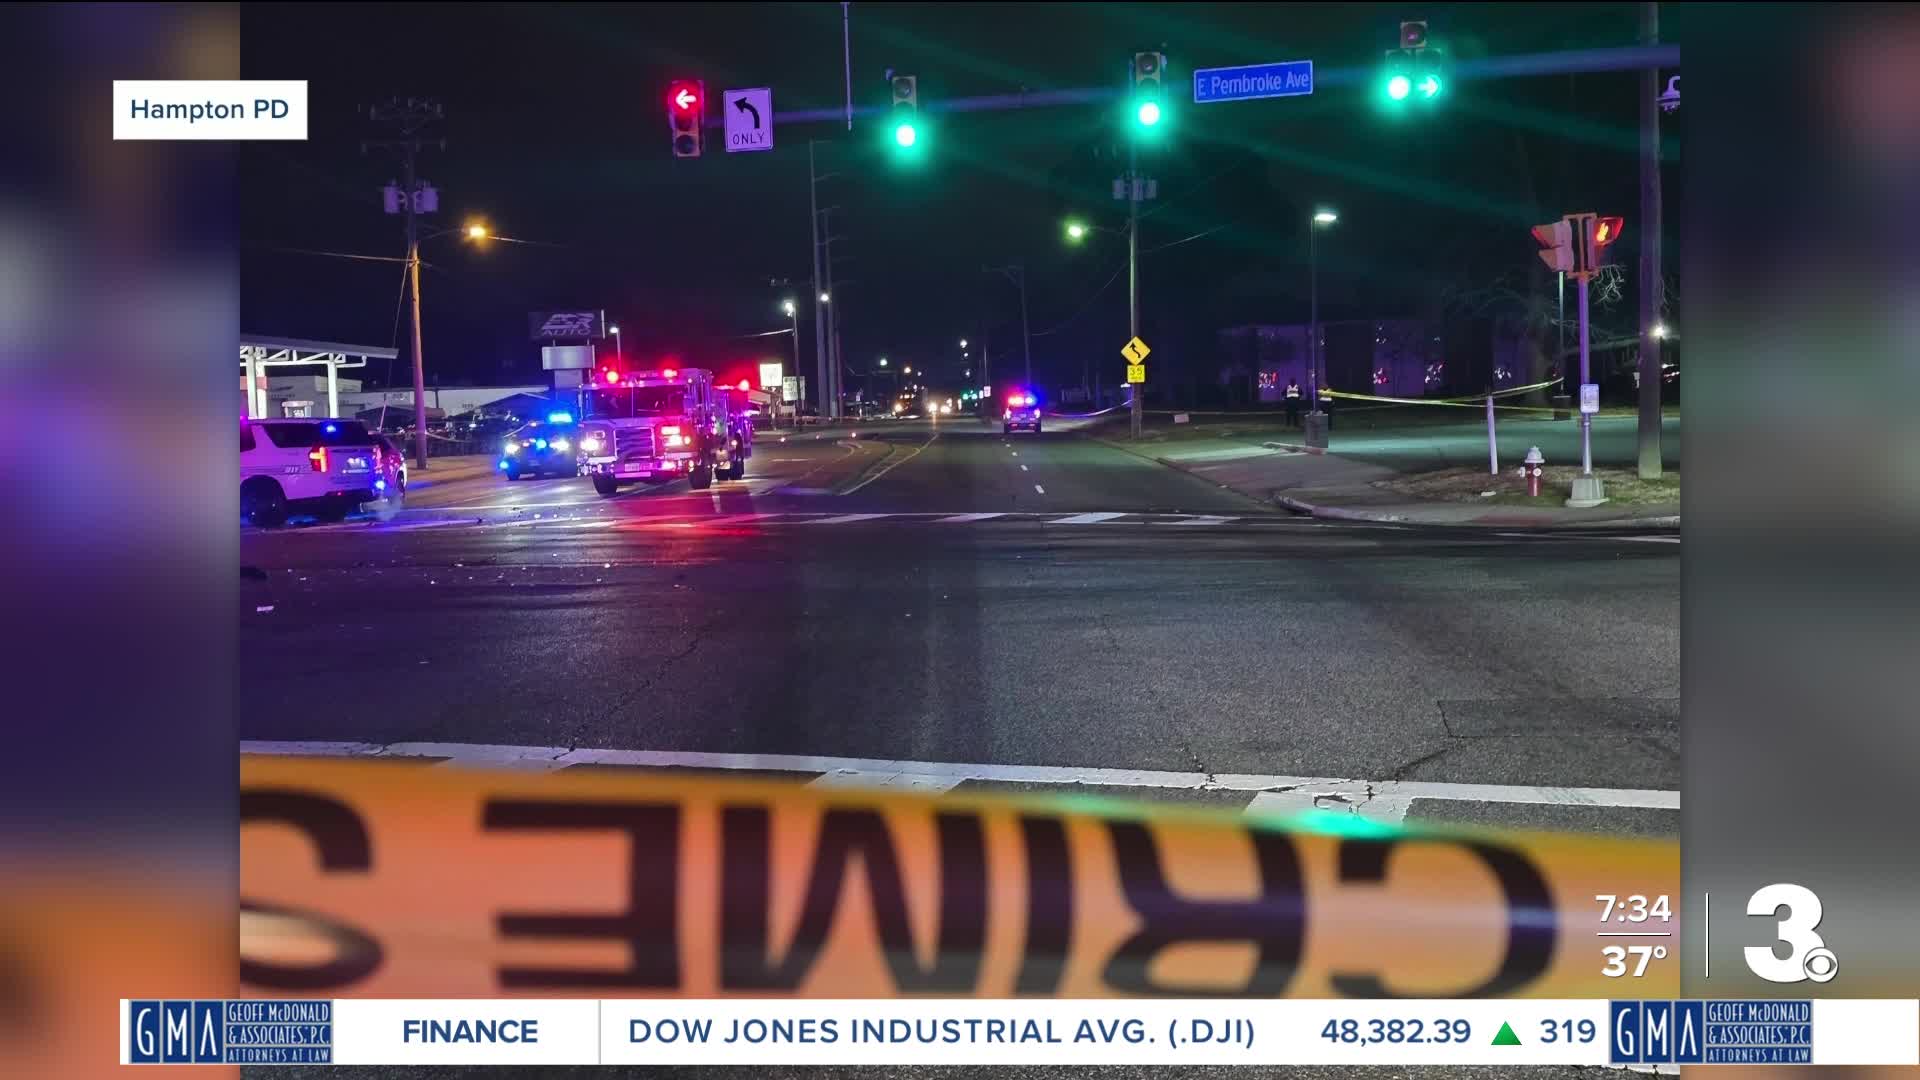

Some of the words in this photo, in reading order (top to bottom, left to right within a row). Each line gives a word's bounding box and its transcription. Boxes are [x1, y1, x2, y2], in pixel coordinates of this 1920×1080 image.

[1198, 78, 1206, 96] E
[1211, 73, 1281, 95] Pembroke
[1286, 71, 1309, 89] Ave
[732, 132, 765, 145] ONLY
[542, 328, 592, 336] AUTO
[478, 797, 1560, 997] CRIME
